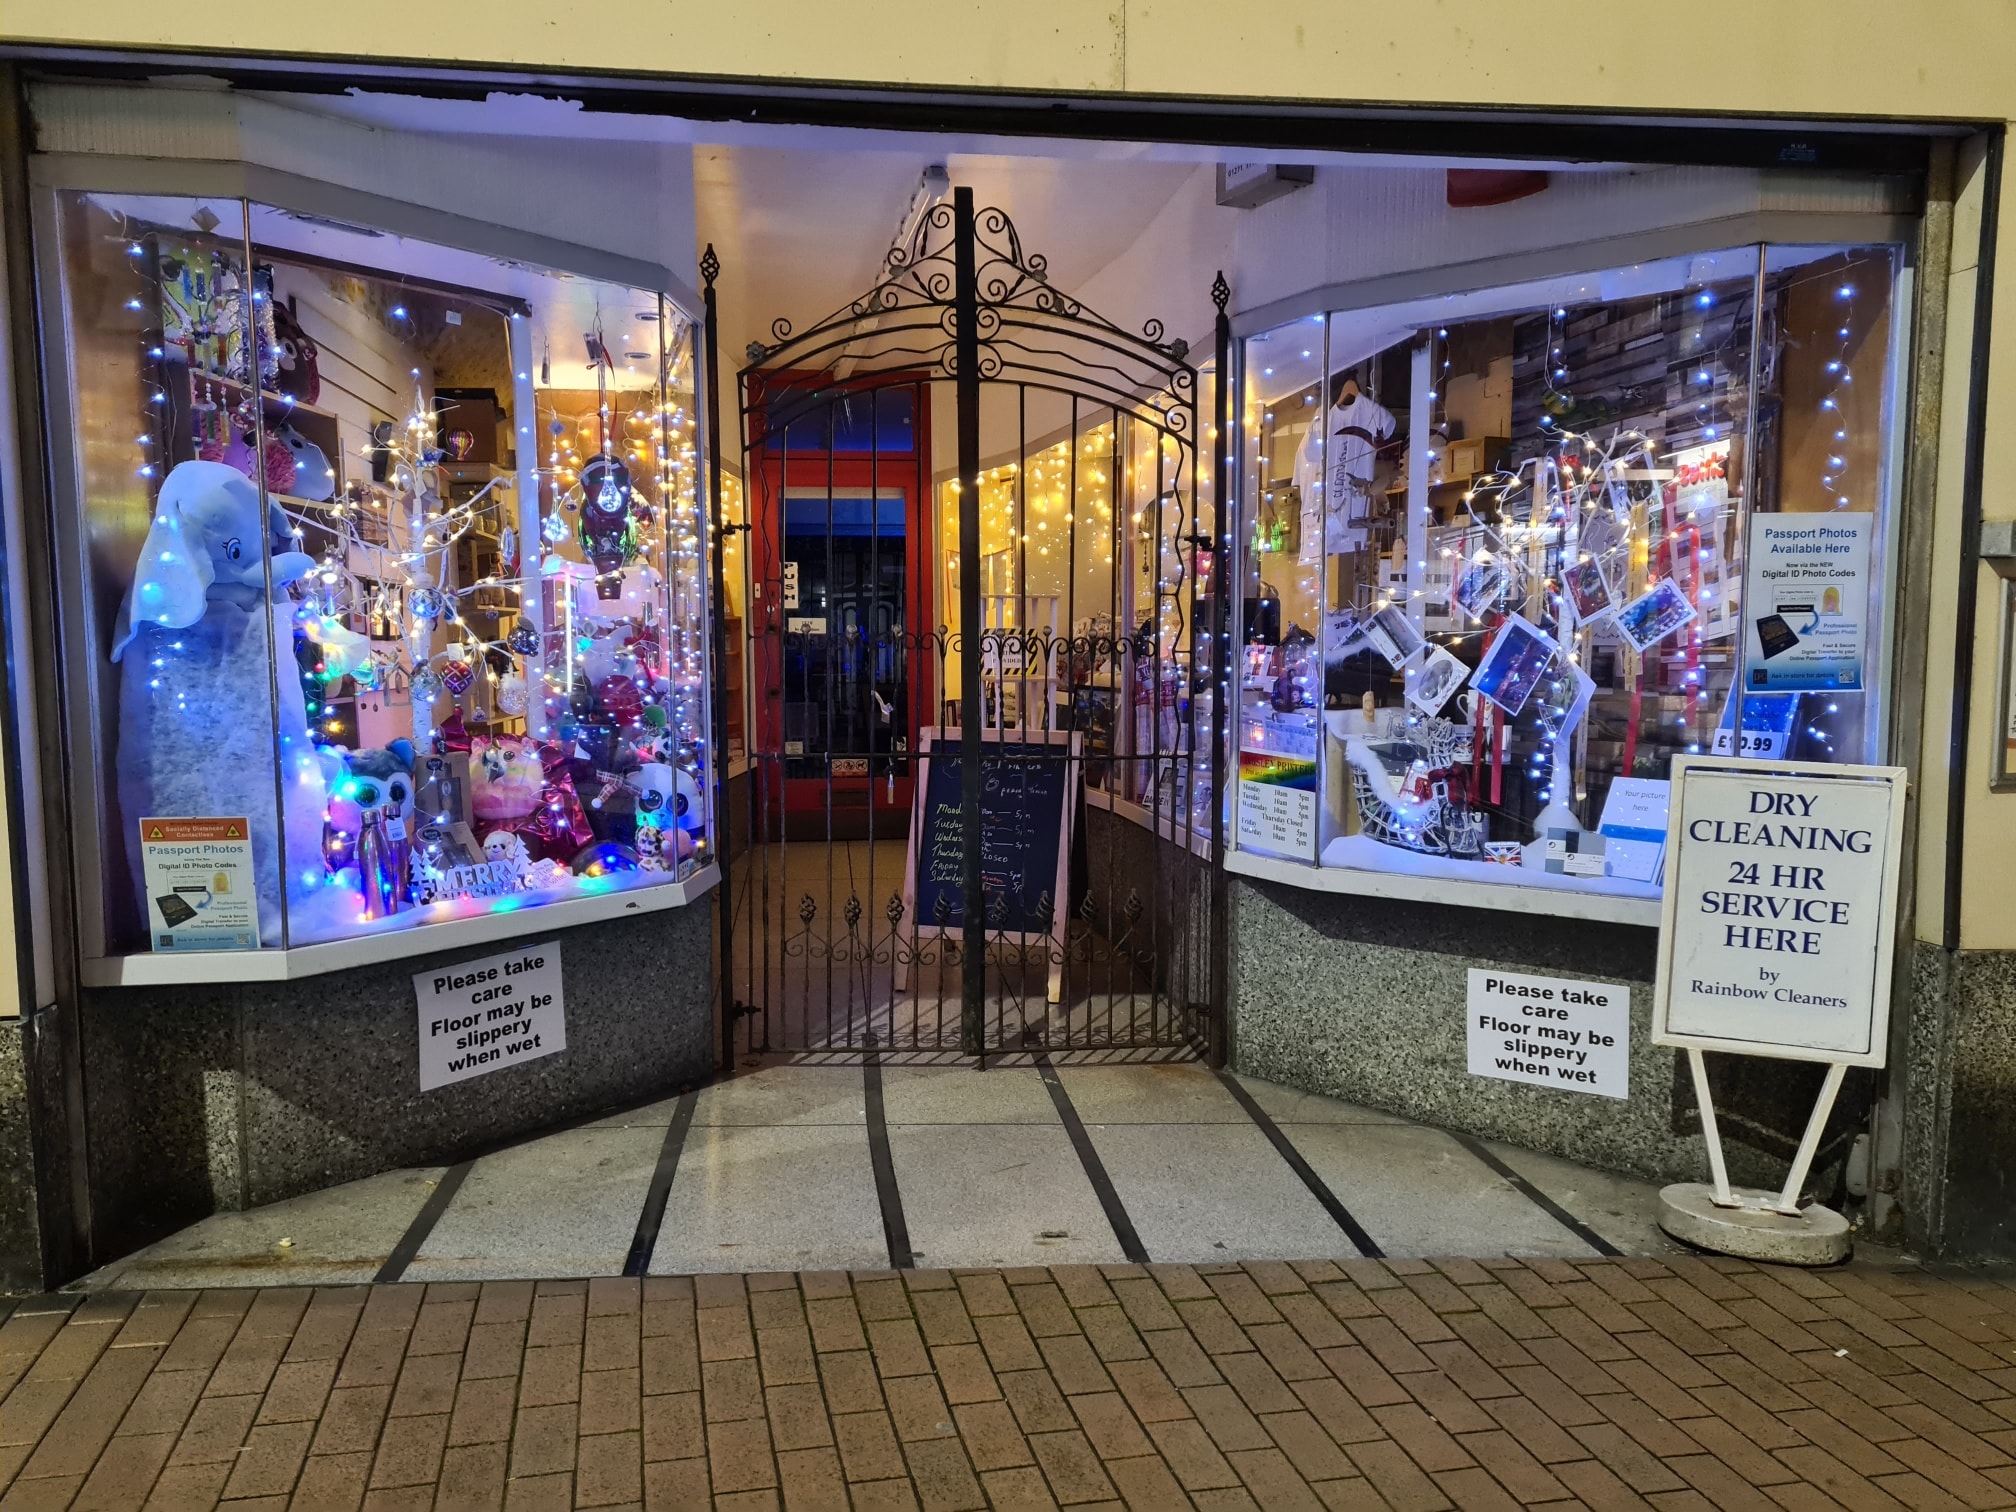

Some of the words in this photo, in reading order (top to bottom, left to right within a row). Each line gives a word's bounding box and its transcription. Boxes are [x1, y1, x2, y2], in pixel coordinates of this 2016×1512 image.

[1765, 528, 1816, 541] Passport
[1819, 528, 1858, 538] Photos
[1770, 543, 1822, 554] Available
[1825, 544, 1850, 554] Here
[784, 563, 796, 601] PUSH
[1762, 570, 1789, 580] Digital
[1791, 570, 1800, 578] ID
[1802, 569, 1827, 578] Photo
[1829, 569, 1856, 577] Codes
[1242, 792, 1260, 804] Tuesday
[1273, 798, 1288, 807] 10am
[1298, 802, 1309, 811] 5pm
[1243, 783, 1261, 795] Monday
[1274, 789, 1288, 798] 10am
[1298, 793, 1310, 802] 5pm
[1625, 789, 1639, 797] Your
[1640, 790, 1666, 799] picture
[1749, 791, 1818, 817] DRY
[1242, 800, 1267, 813] Wednesday
[1273, 807, 1287, 815] 10am
[1298, 812, 1309, 820] 5pm
[1632, 804, 1648, 812] here
[1241, 817, 1257, 828] Friday
[1272, 824, 1287, 833] 10am
[1296, 829, 1308, 838] 5pm
[1262, 813, 1285, 826] Thursday
[1286, 818, 1303, 828] Closed
[1240, 826, 1262, 838] Saturday
[1272, 833, 1286, 842] 10am
[1295, 838, 1307, 847] 5pm
[1689, 819, 1872, 854] CLEANING
[148, 846, 201, 856] Passport
[203, 845, 244, 854] Photos
[158, 863, 181, 871] Digital
[434, 858, 519, 891] MERRY
[1727, 861, 1760, 885] 24
[1770, 864, 1825, 890] HR
[1701, 891, 1850, 925] SERVICE
[1723, 924, 1821, 955] HERE
[433, 968, 498, 994] Please
[503, 956, 545, 976] take
[1759, 966, 1780, 985] by
[471, 984, 513, 1005] care
[1486, 978, 1554, 1000] Please
[1561, 988, 1609, 1007] take
[1690, 980, 1768, 1000] Rainbow
[1774, 988, 1847, 1008] Cleaners
[431, 1013, 482, 1037] Floor
[486, 1001, 525, 1022] may
[531, 994, 553, 1009] be
[1521, 1005, 1569, 1021] care
[456, 1018, 532, 1050] slippery
[1479, 1015, 1531, 1035] Floor
[1537, 1025, 1581, 1046] may
[1588, 1030, 1615, 1047] be
[447, 1048, 501, 1072] when
[505, 1033, 542, 1055] wet
[1504, 1038, 1588, 1066] slippery
[1495, 1057, 1550, 1076] when
[1557, 1067, 1597, 1084] wet
